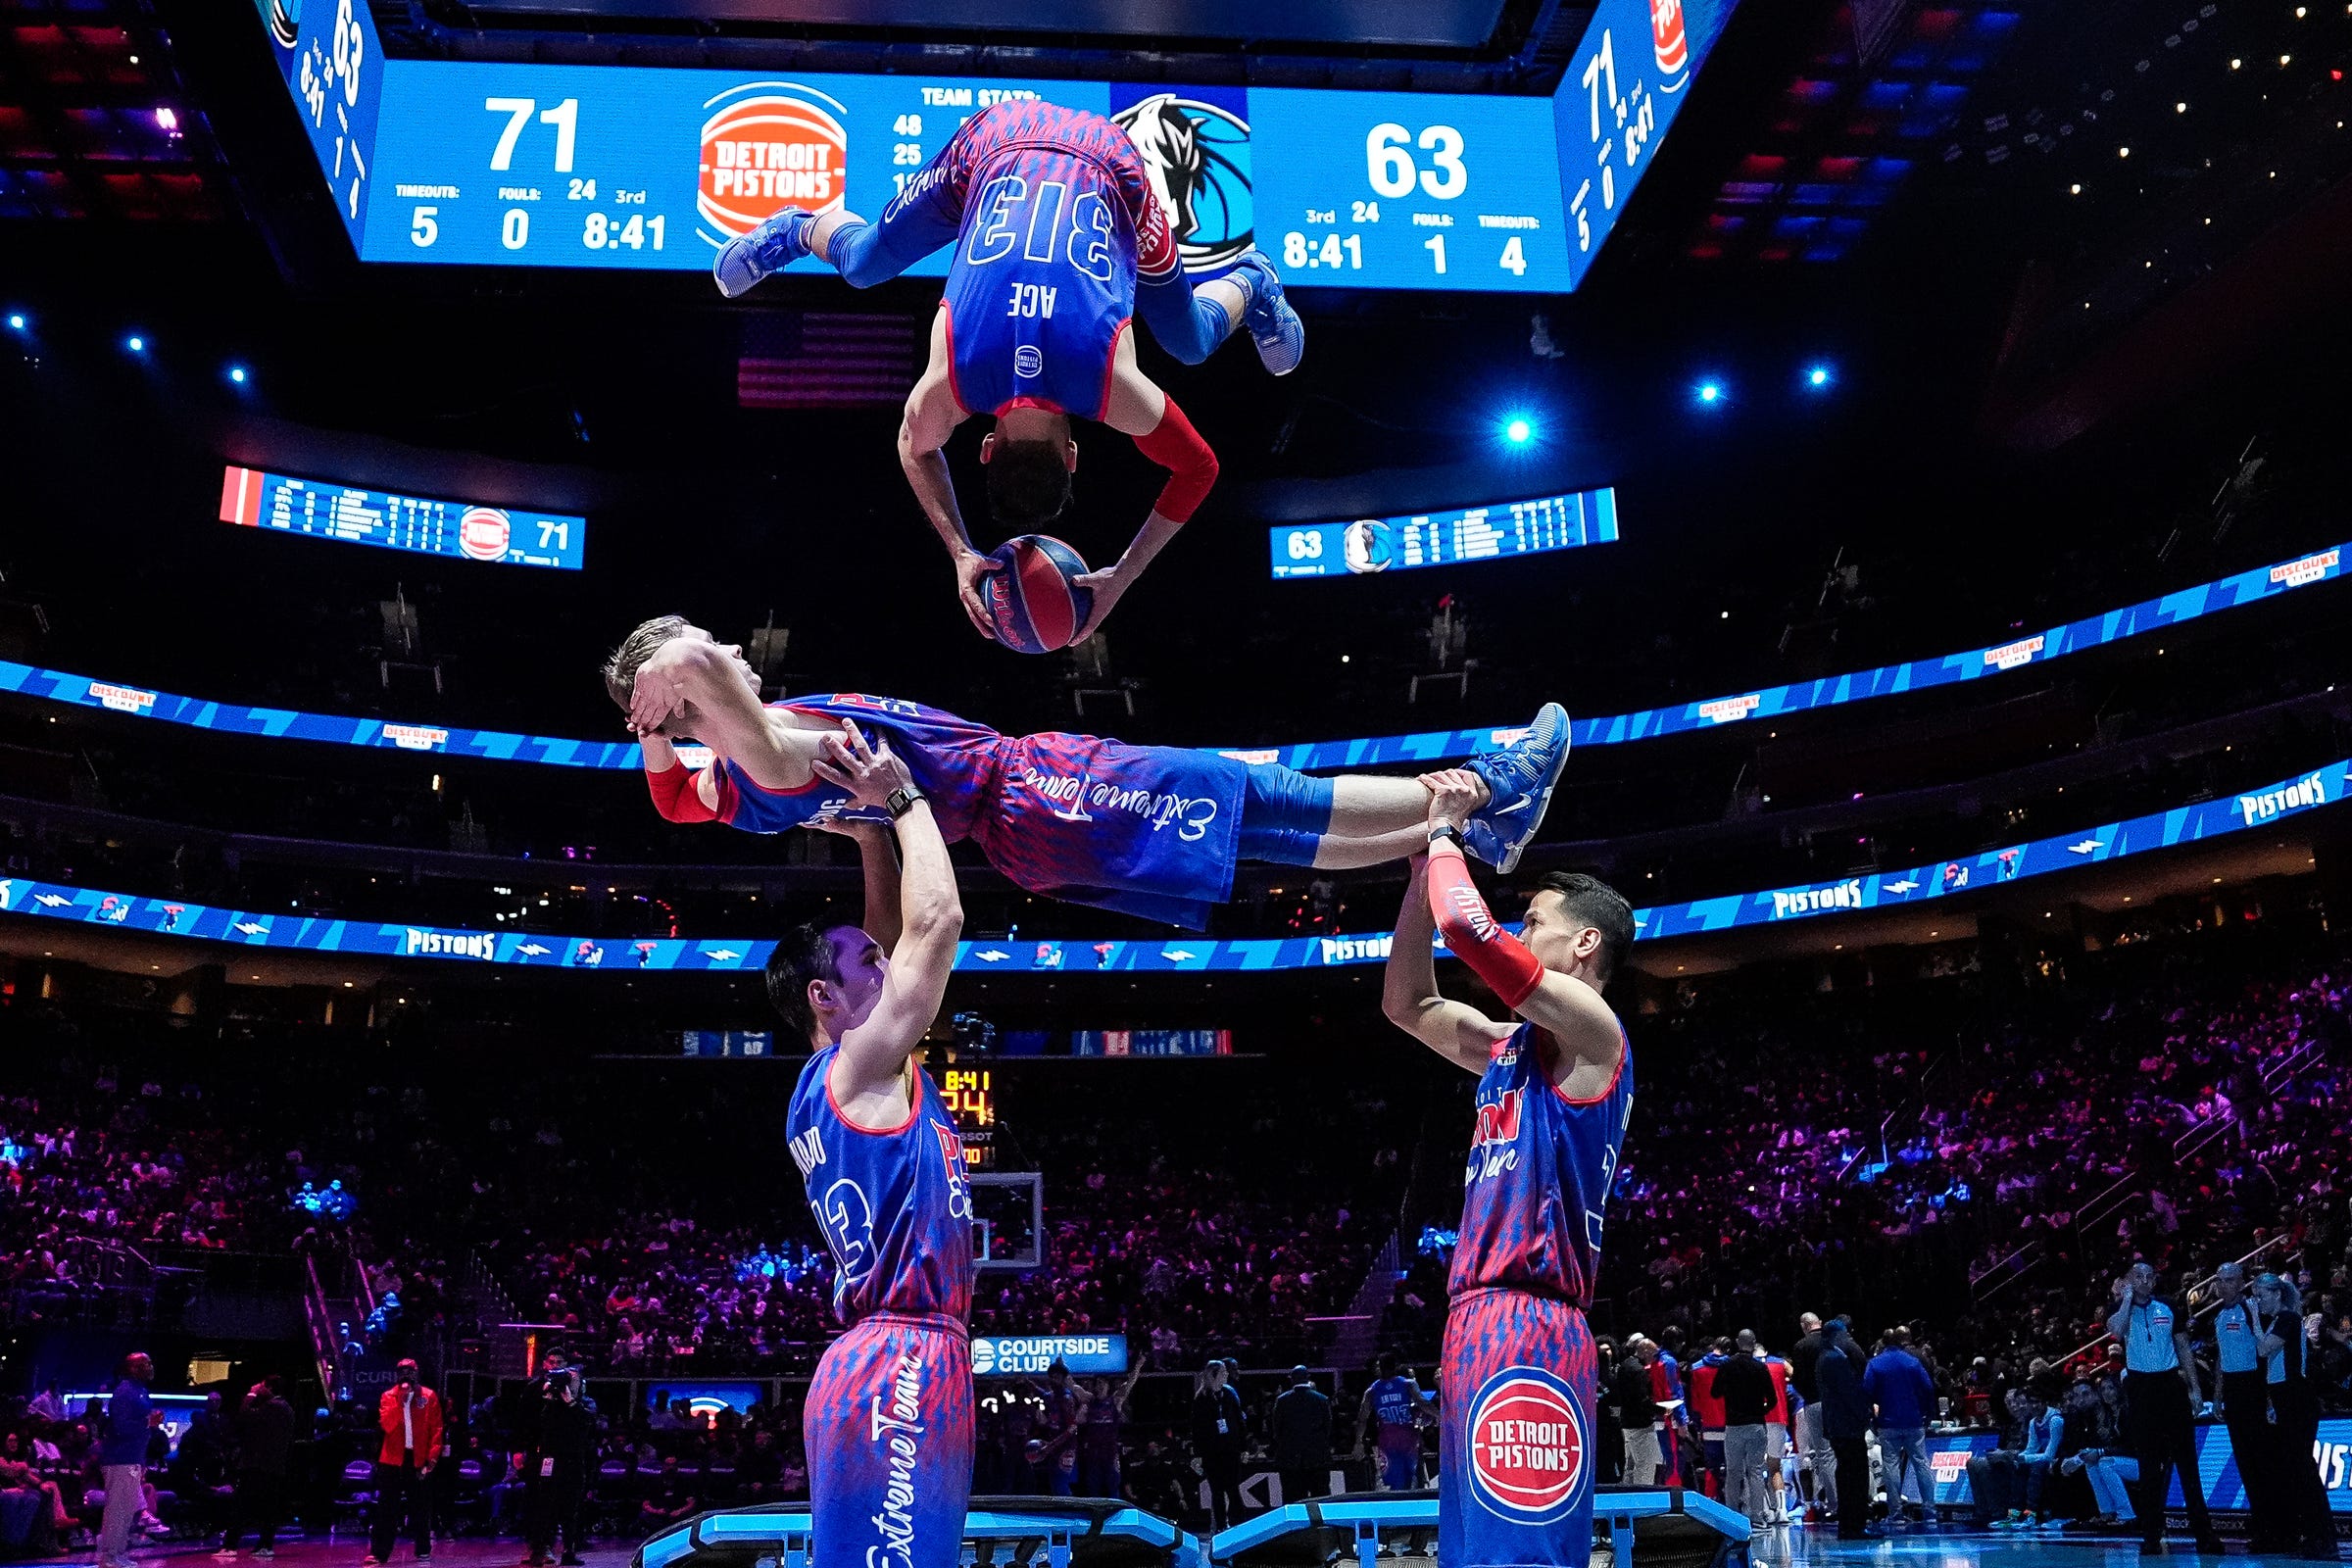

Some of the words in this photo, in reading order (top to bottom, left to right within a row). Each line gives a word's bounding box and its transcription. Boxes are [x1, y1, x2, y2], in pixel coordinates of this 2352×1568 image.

[921, 87, 972, 106] TEAM
[485, 97, 578, 172] 71
[893, 114, 922, 136] 48
[714, 141, 831, 171] DETROIT
[893, 143, 922, 166] 25
[1366, 122, 1468, 200] 63
[395, 184, 461, 199] TIMEOUTS:
[498, 187, 541, 201] FOULS:
[567, 178, 597, 201] 24
[615, 189, 646, 204] 3rd
[712, 169, 832, 199] PISTONS
[1306, 209, 1336, 223] 3rd
[1351, 200, 1380, 222] 24
[1412, 213, 1454, 226] FOULS:
[1478, 215, 1541, 229] TIMEOUTS:
[411, 206, 438, 248] 5
[502, 208, 529, 250] 0
[582, 212, 665, 251] 8:41
[966, 174, 1113, 281] 313
[1283, 231, 1362, 270] 8:41
[1424, 233, 1446, 274] 1
[1499, 236, 1527, 276] 4
[1006, 282, 1057, 318] ACE
[536, 520, 569, 550] 71
[1288, 530, 1323, 560] 63
[2272, 553, 2336, 579] DISCOUNT
[92, 685, 153, 705] DISCOUNT
[1020, 766, 1094, 823] Team
[2239, 770, 2326, 826] PISTONS
[1089, 783, 1217, 841] Extreme
[1773, 878, 1862, 918] PISTONS
[1447, 886, 1500, 942] PISTONS
[407, 927, 495, 960] PISTONS
[1320, 935, 1394, 964] PISTON
[945, 1070, 990, 1092] 8:41
[959, 1132, 993, 1142] SSOT
[998, 1338, 1109, 1356] COURTSIDE
[998, 1356, 1051, 1373] CLUB
[871, 1350, 924, 1441] Team
[1488, 1419, 1569, 1446] DETROIT
[1488, 1445, 1569, 1472] PISTONS
[866, 1433, 917, 1568] Extreme
